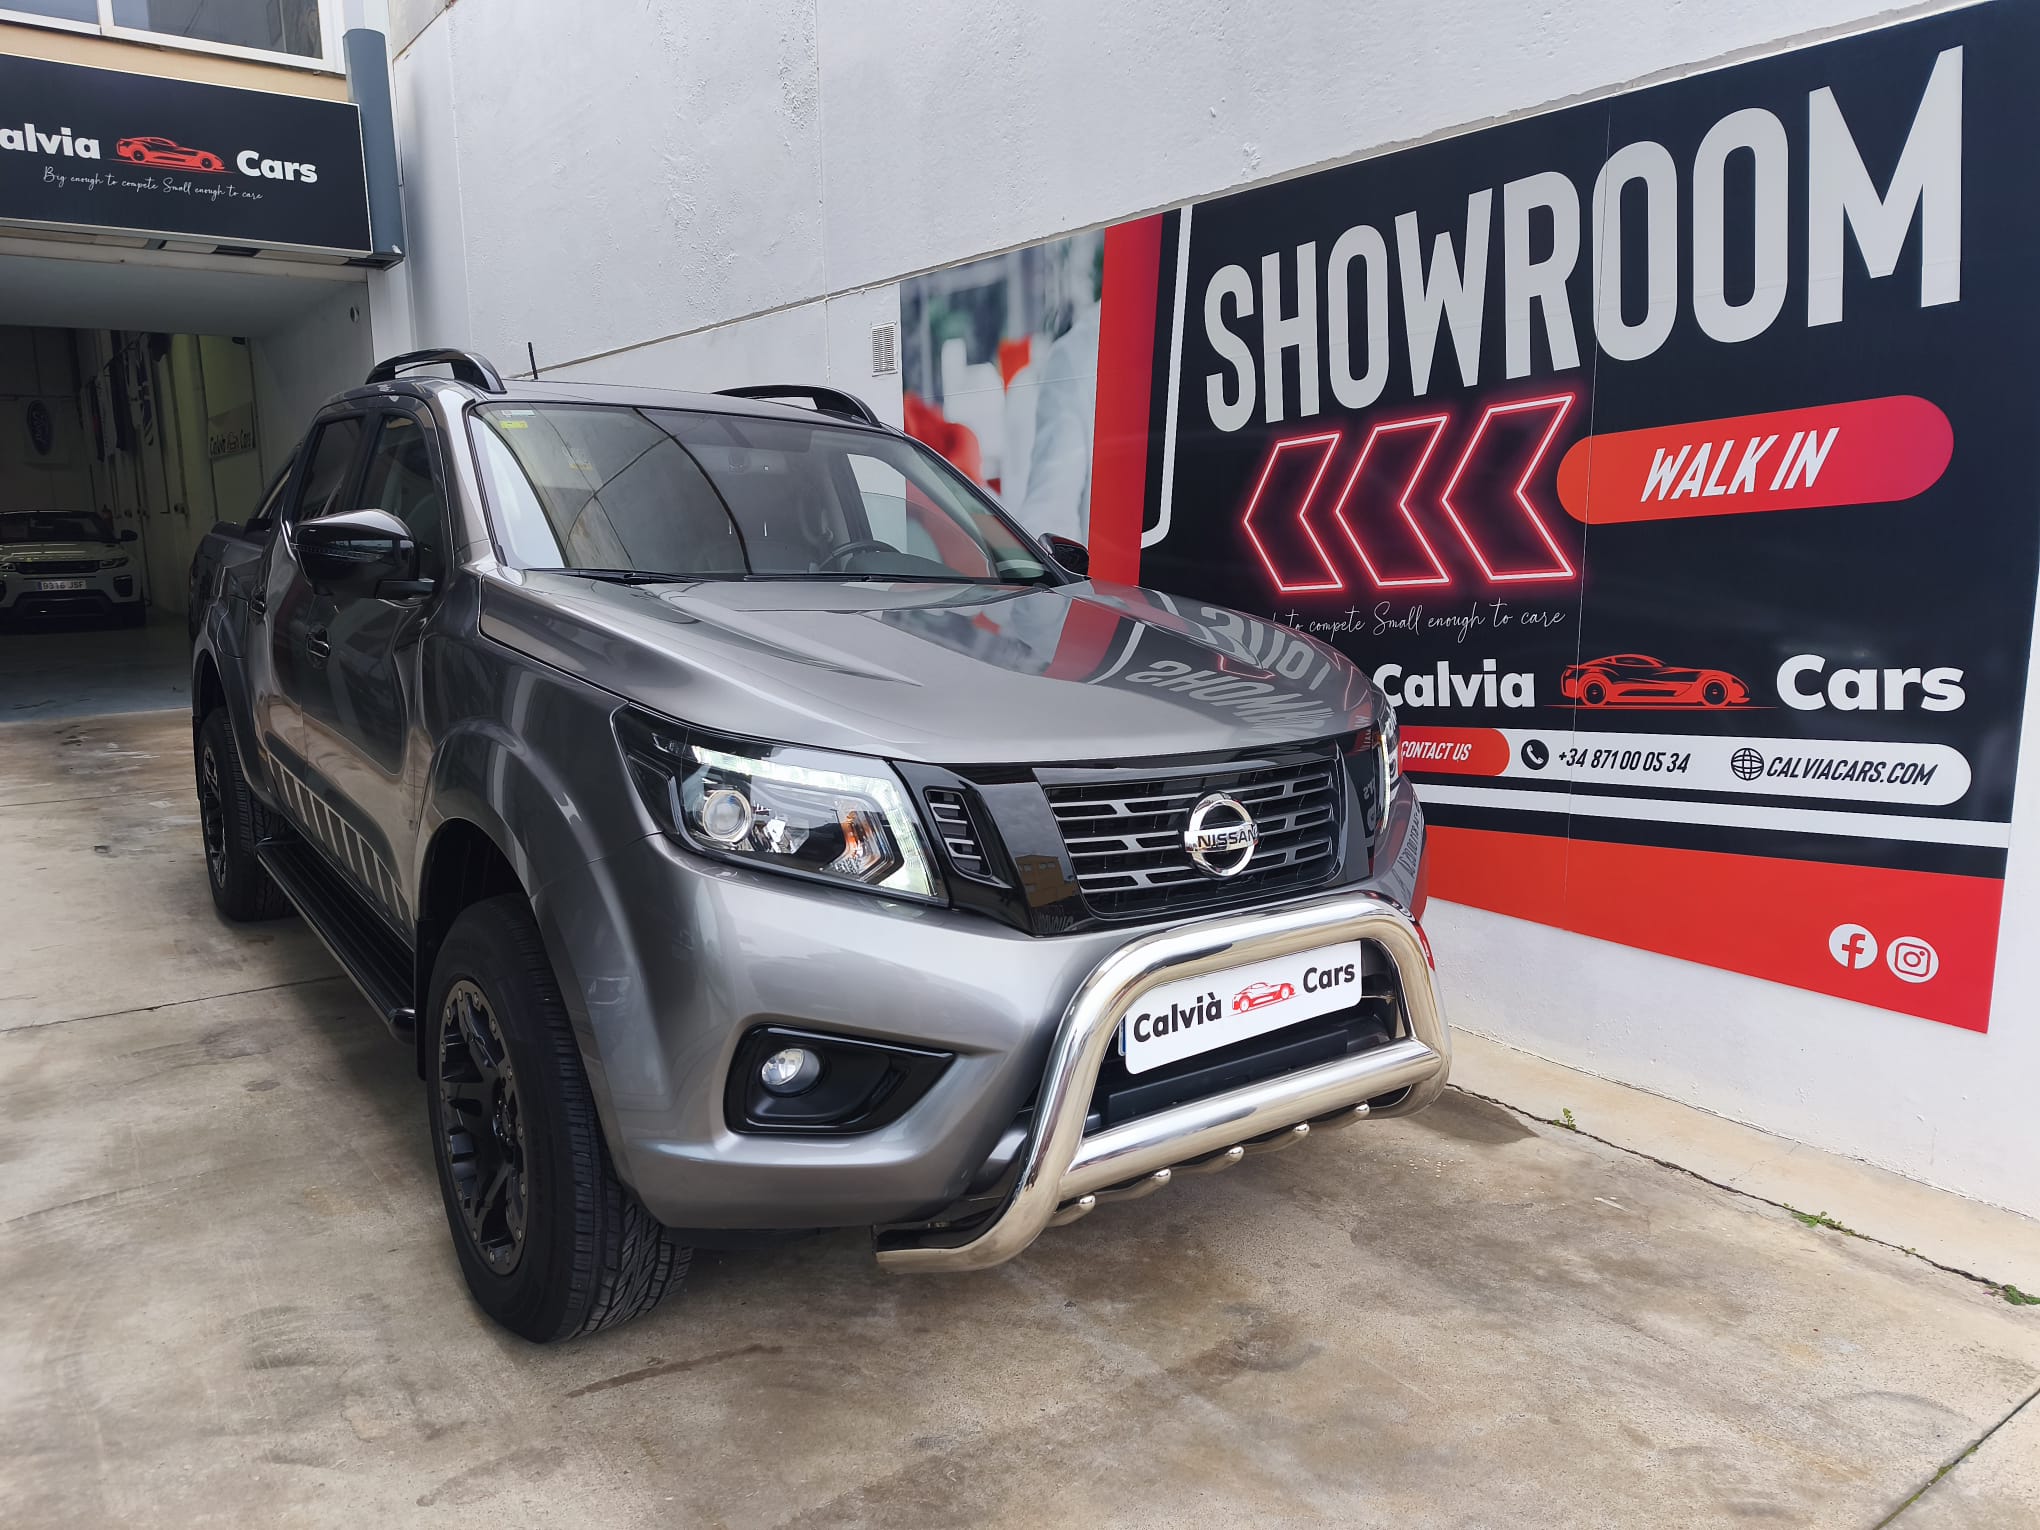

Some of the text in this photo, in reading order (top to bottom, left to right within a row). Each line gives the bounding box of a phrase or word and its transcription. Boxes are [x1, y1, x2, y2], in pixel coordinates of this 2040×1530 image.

[43, 166, 264, 201] Big enough to compete Small enough to care
[236, 150, 318, 183] Cars
[1204, 46, 1964, 432] SHOWROOM
[1640, 427, 1840, 503] WALK IN
[1309, 604, 1365, 642] compete
[1373, 600, 1423, 636] Small
[1428, 601, 1486, 644] enough
[1489, 597, 1514, 628] to
[1520, 610, 1566, 628] care
[1372, 654, 1966, 712] Calvia Cars
[1401, 740, 1472, 761] CONTACT US
[1558, 747, 1691, 774] +34 871 00 05 34
[1766, 756, 1938, 786] CALVIACARS.COM
[1197, 826, 1257, 848] NISSAN
[1133, 964, 1355, 1042] Calvià Cars
